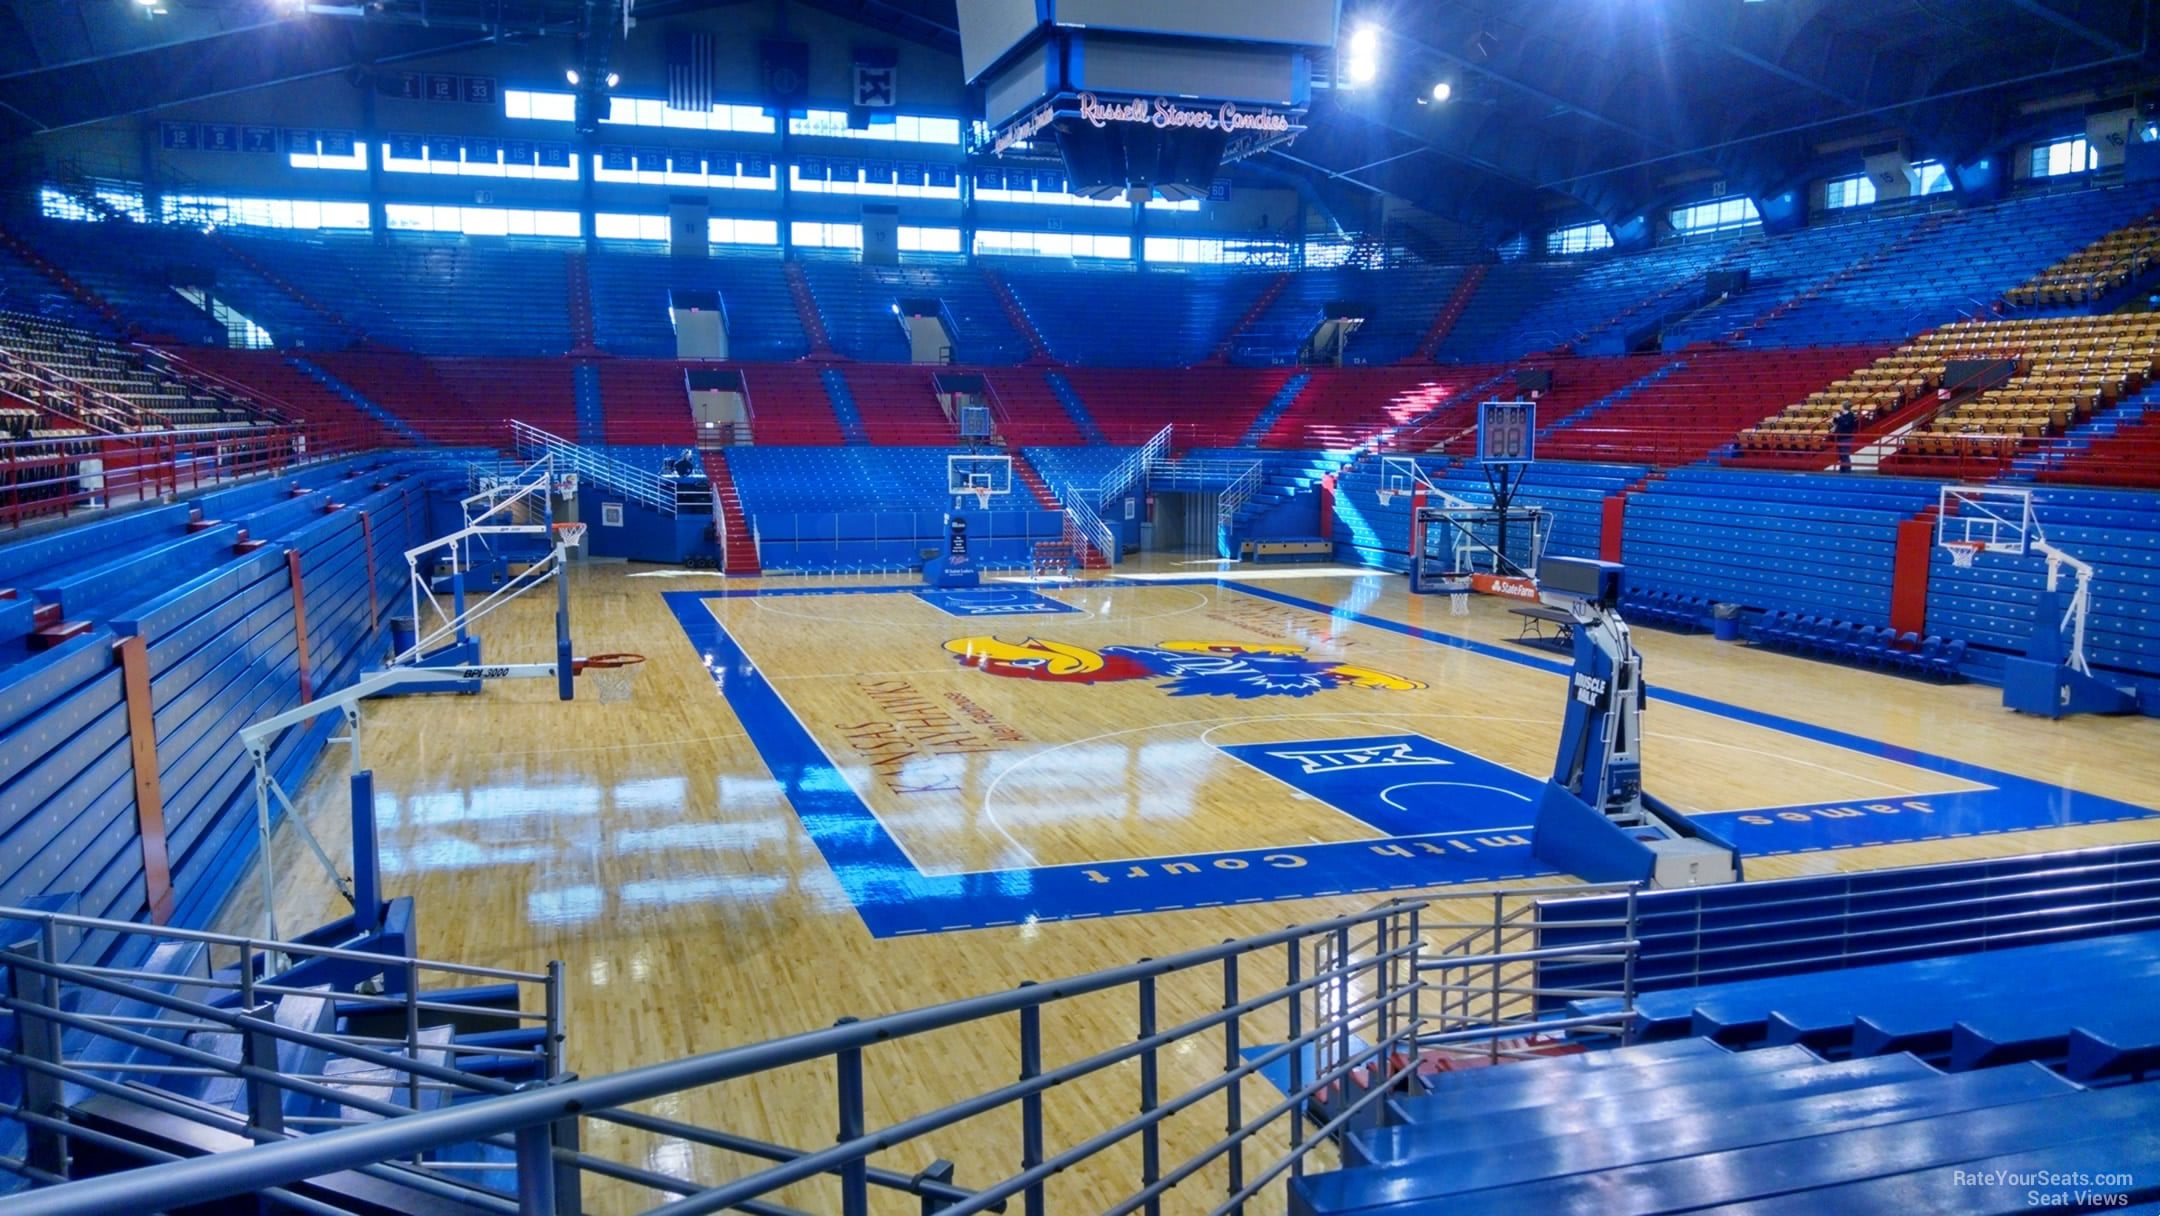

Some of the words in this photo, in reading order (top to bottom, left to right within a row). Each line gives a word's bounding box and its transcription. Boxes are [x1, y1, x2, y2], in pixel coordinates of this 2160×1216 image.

[435, 82, 449, 95] 12
[471, 84, 488, 97] 33
[1077, 91, 1150, 128] Russell
[1152, 96, 1218, 129] Stover
[1219, 101, 1289, 132] Candies
[172, 131, 188, 144] 12
[2105, 132, 2124, 146] 16
[474, 145, 489, 157] 10
[547, 149, 561, 162] 18
[1880, 172, 1894, 184] 15
[1572, 599, 1588, 616] KU
[484, 668, 510, 678] 3000
[1574, 672, 1606, 695] MUSCLE
[1577, 687, 1598, 706] MILK
[857, 680, 1013, 756] JAYHAWKS
[1737, 801, 1935, 825] James
[1369, 833, 1533, 859] mith
[1081, 853, 1308, 883] Court
